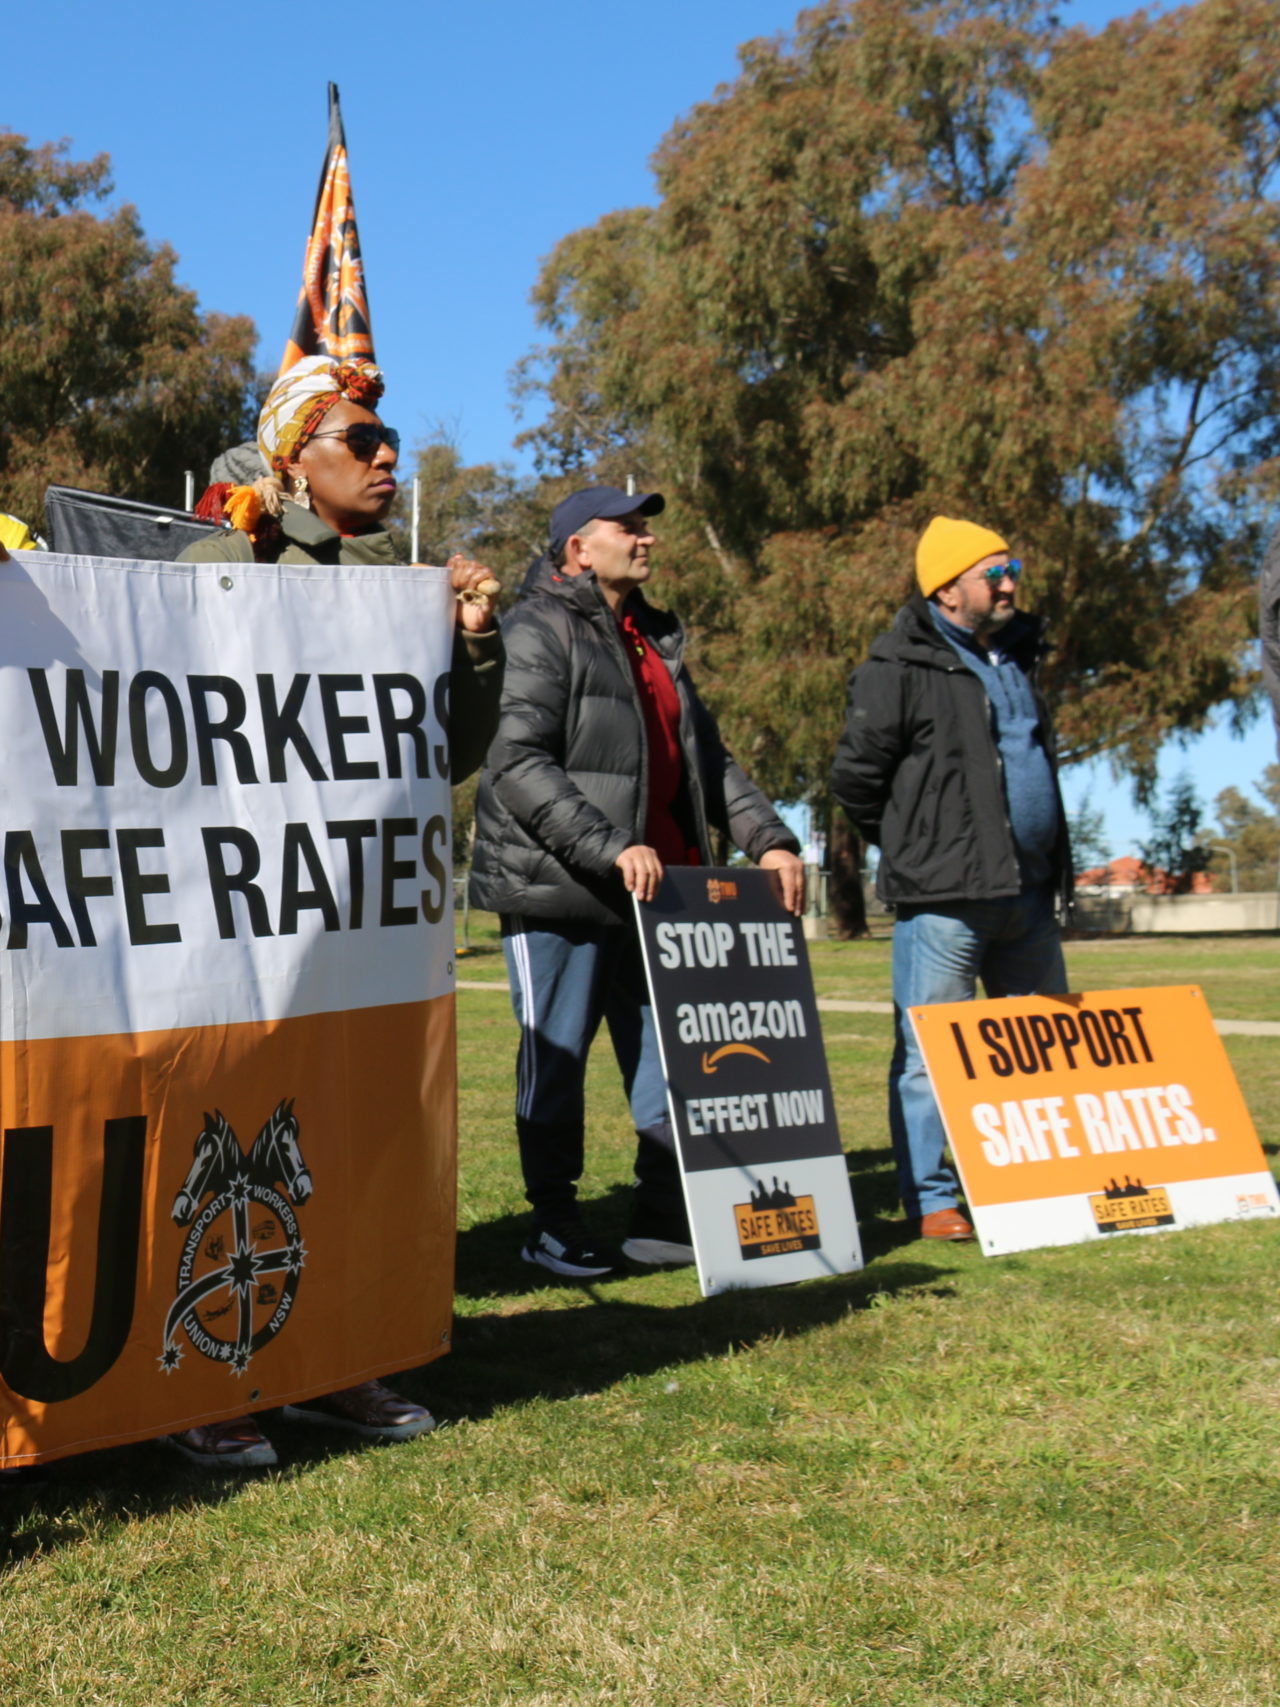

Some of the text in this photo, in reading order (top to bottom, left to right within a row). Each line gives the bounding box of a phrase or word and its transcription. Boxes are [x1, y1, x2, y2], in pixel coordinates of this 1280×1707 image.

[201, 815, 447, 939] RATES
[656, 922, 798, 969] STOP THE
[676, 1000, 807, 1044] amazon
[950, 1007, 1154, 1080] I SUPPORT
[686, 1089, 825, 1136] EFFECT NOW
[971, 1084, 1217, 1166] SAFE RATES.
[740, 1209, 814, 1240] SAFE RATES
[1095, 1197, 1168, 1219] SAFE RATES
[179, 1192, 227, 1288] TRANSPORT
[183, 1313, 220, 1358] UNION
[269, 1292, 293, 1333] NSW
